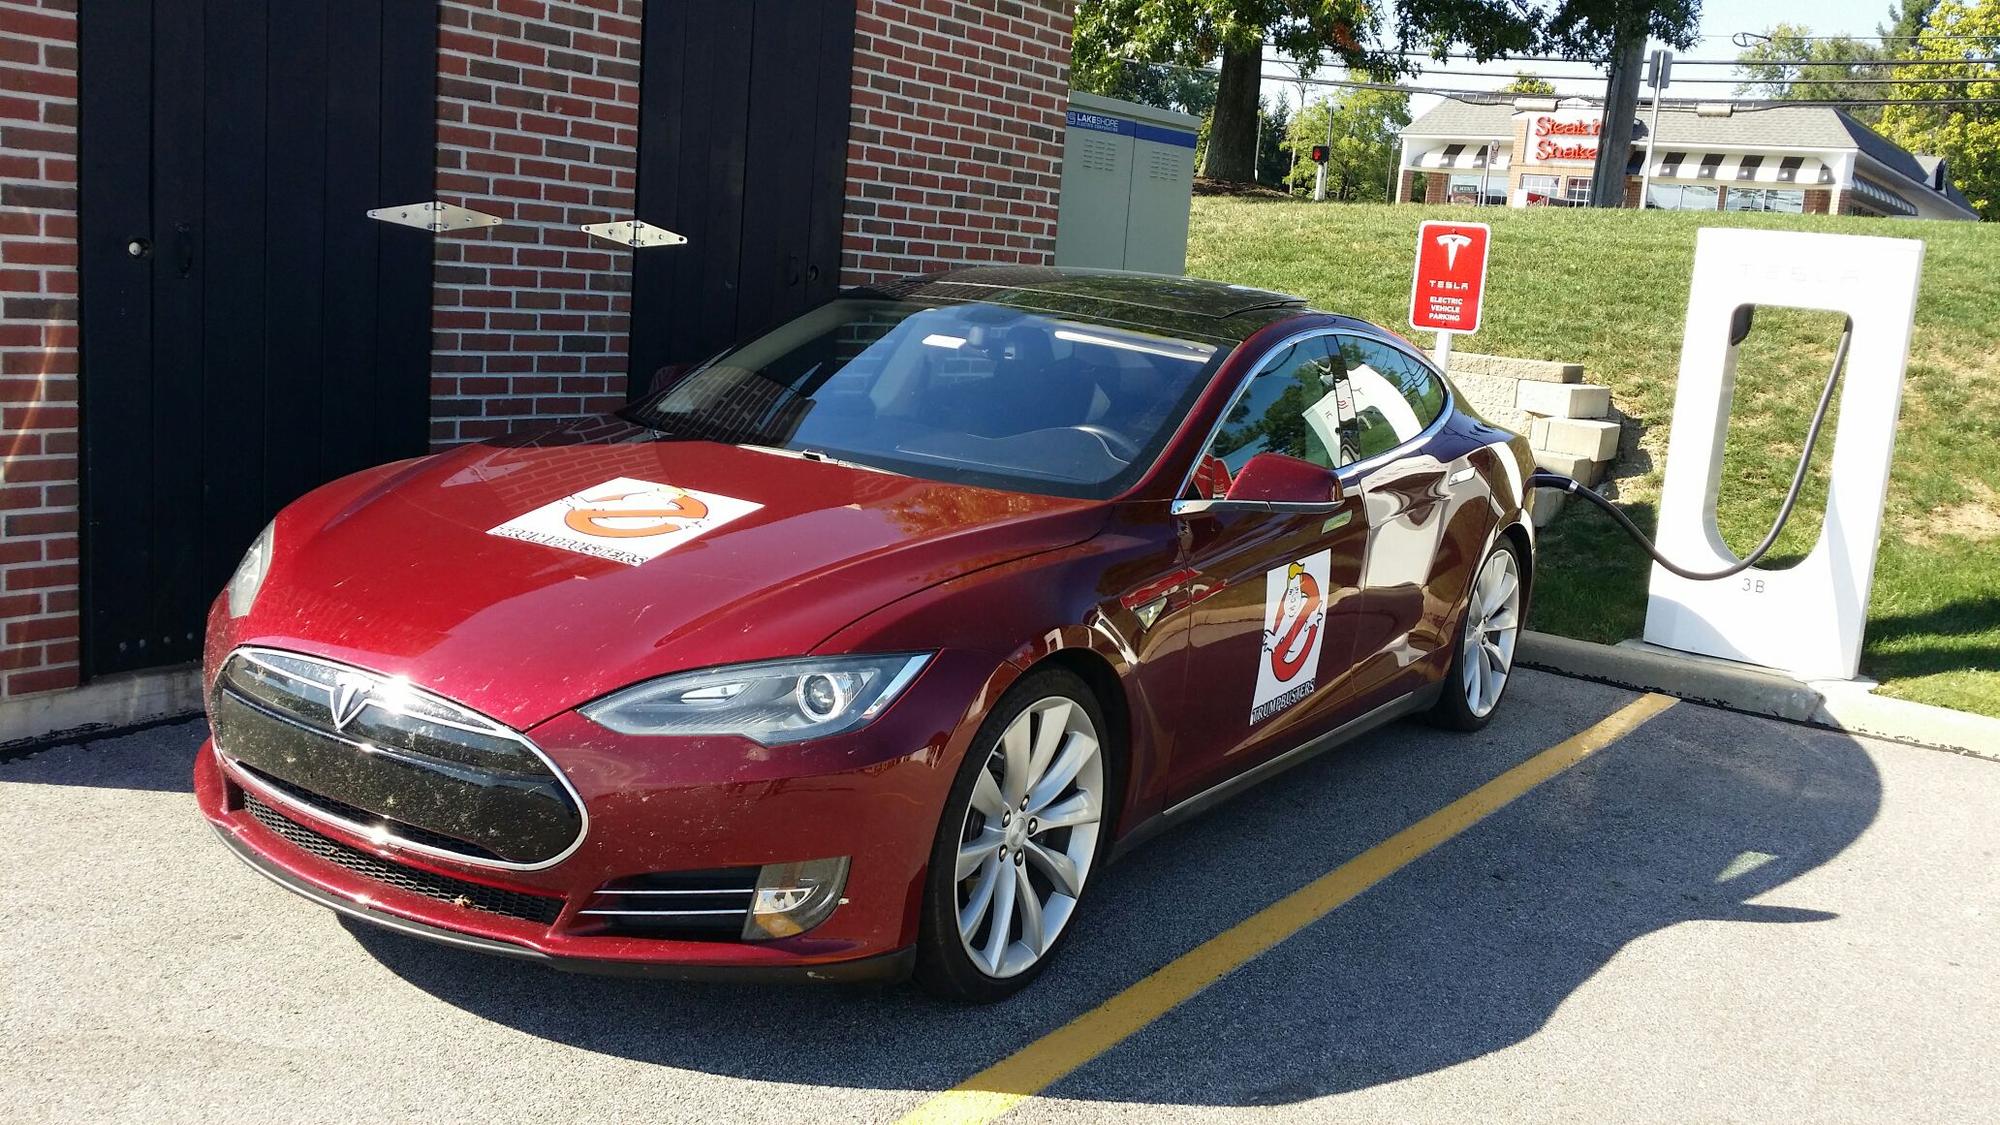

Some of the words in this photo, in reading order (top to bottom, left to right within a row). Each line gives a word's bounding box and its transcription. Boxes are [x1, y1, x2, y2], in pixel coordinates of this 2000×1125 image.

[1535, 116, 1588, 136] Steak
[1535, 140, 1598, 160] Shake
[1428, 280, 1469, 290] TESLA
[1429, 296, 1463, 305] ELECTRIC
[1430, 304, 1461, 313] VEHICLE
[1428, 312, 1460, 321] PARKING
[1252, 678, 1315, 722] TRUMPBUSTERS
